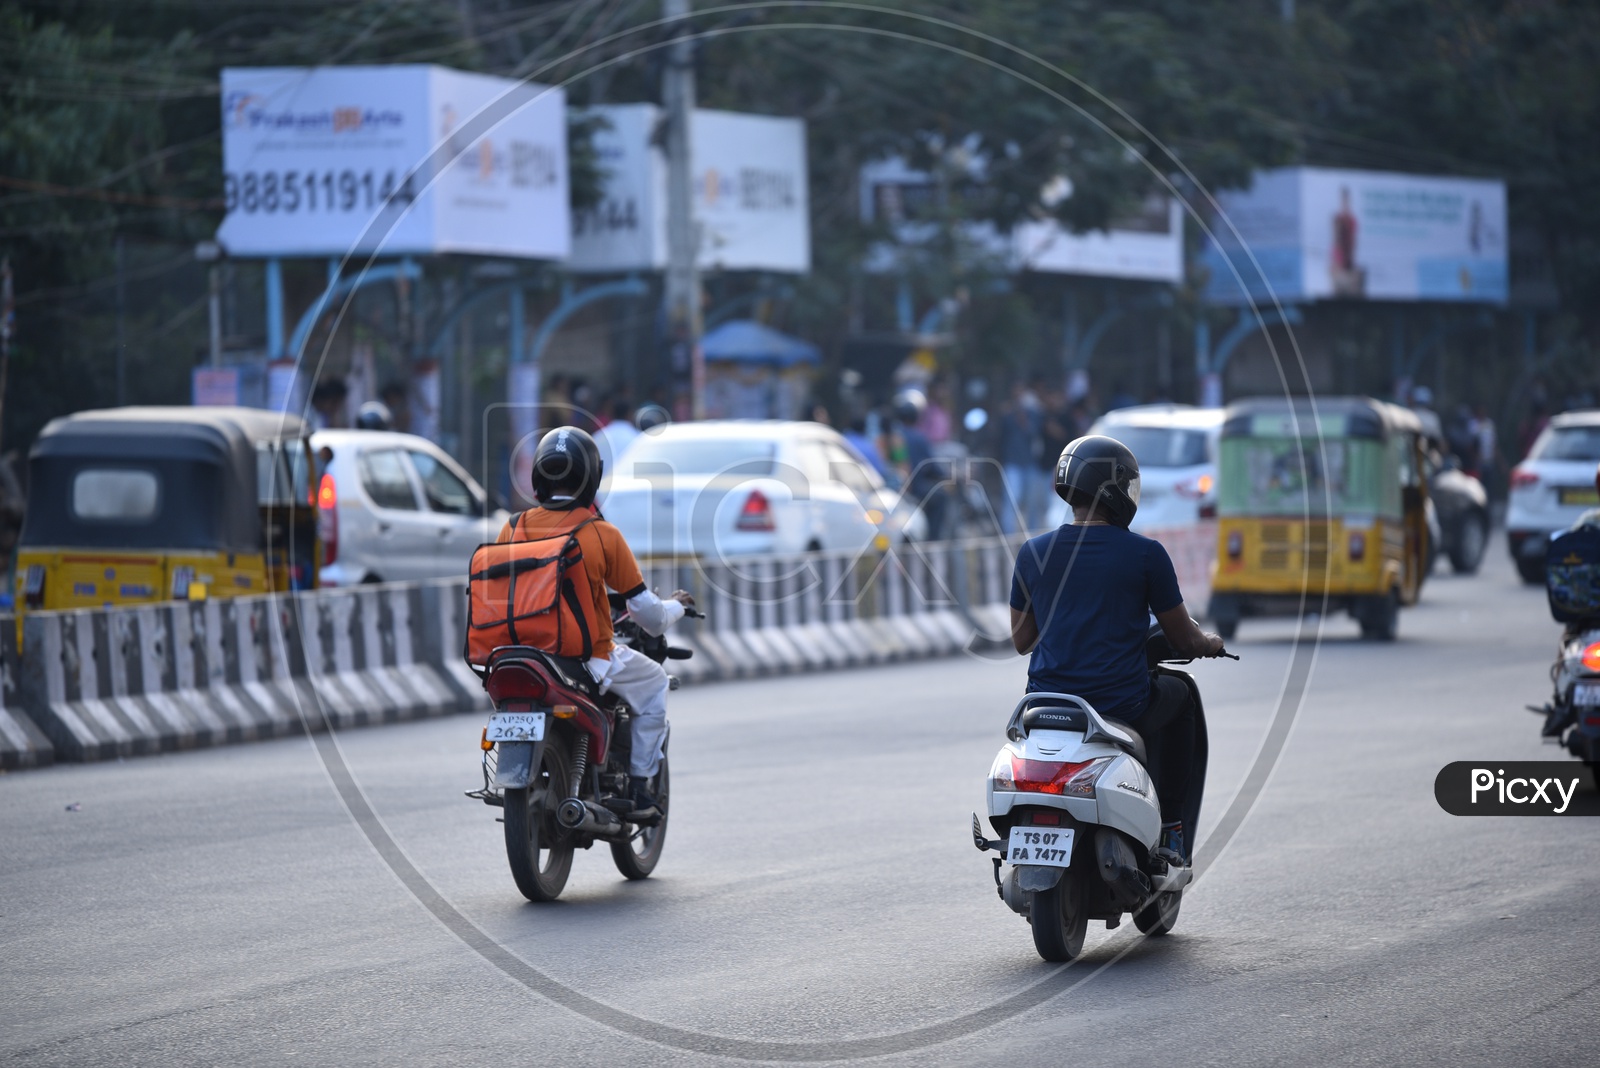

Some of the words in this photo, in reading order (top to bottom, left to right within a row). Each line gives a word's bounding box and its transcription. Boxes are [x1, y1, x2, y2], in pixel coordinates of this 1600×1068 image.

[225, 167, 418, 214] 9885119144
[500, 716, 534, 724] AP25Q
[1039, 713, 1072, 721] HONDA
[494, 726, 536, 738] 2624
[1024, 832, 1041, 844] TS
[1042, 833, 1059, 845] 07
[1012, 848, 1029, 860] FA
[1035, 848, 1067, 862] 7477
